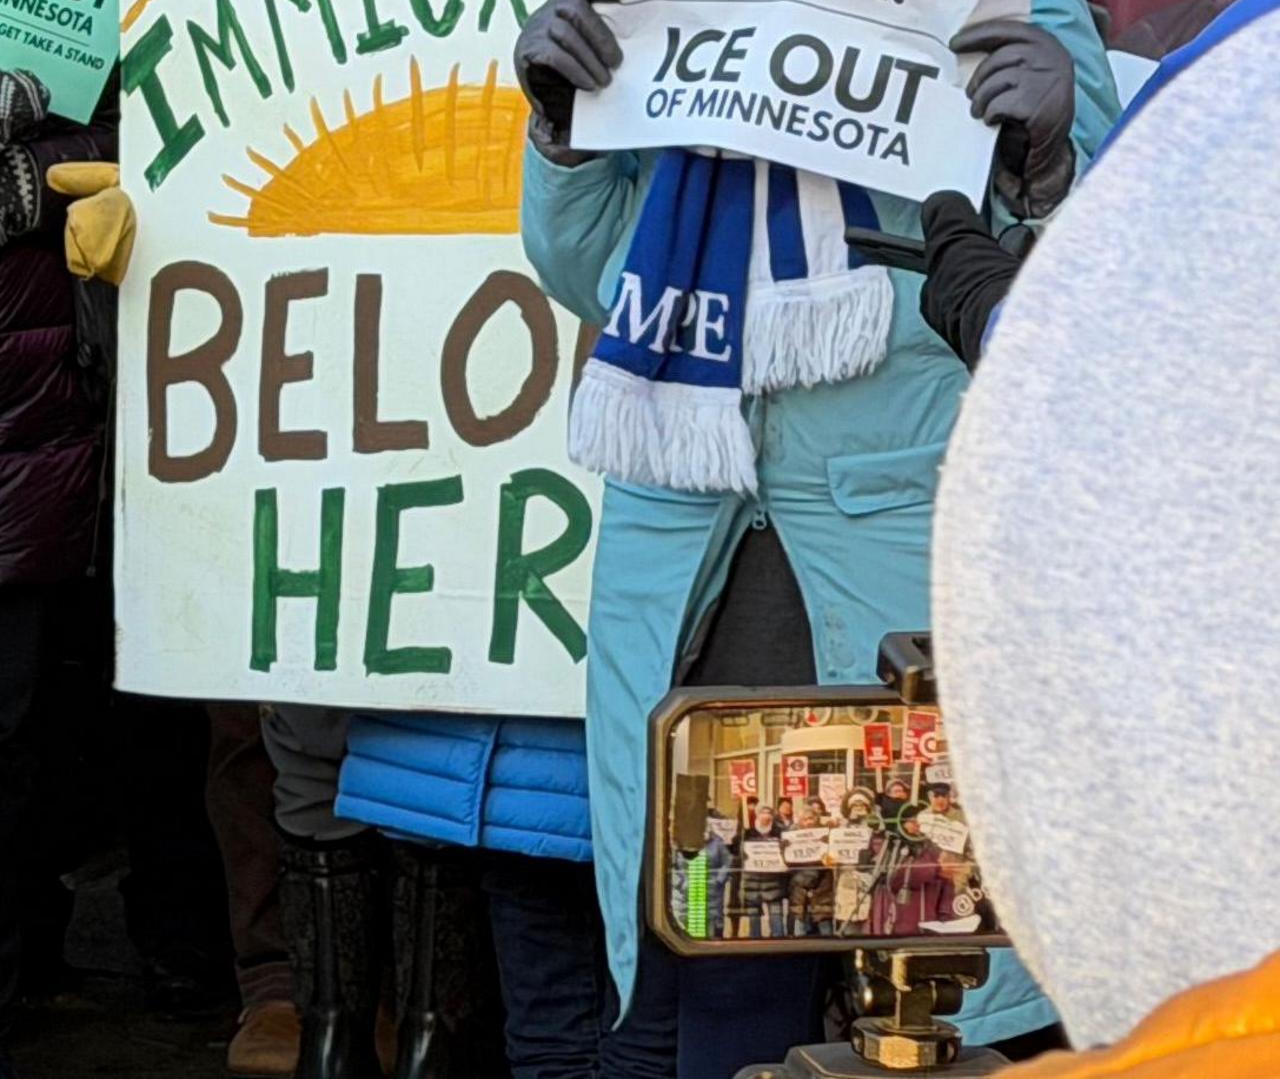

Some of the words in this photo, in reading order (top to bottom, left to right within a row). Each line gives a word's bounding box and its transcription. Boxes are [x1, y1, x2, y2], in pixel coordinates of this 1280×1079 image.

[22, 29, 54, 52] TAKE
[53, 44, 63, 57] A
[65, 47, 105, 71] STAND
[652, 27, 756, 83] ICE
[769, 35, 940, 125] OUT
[645, 88, 683, 119] OF
[689, 88, 910, 167] MINNESOTA
[147, 261, 590, 484] BELO
[250, 469, 593, 676] HER
